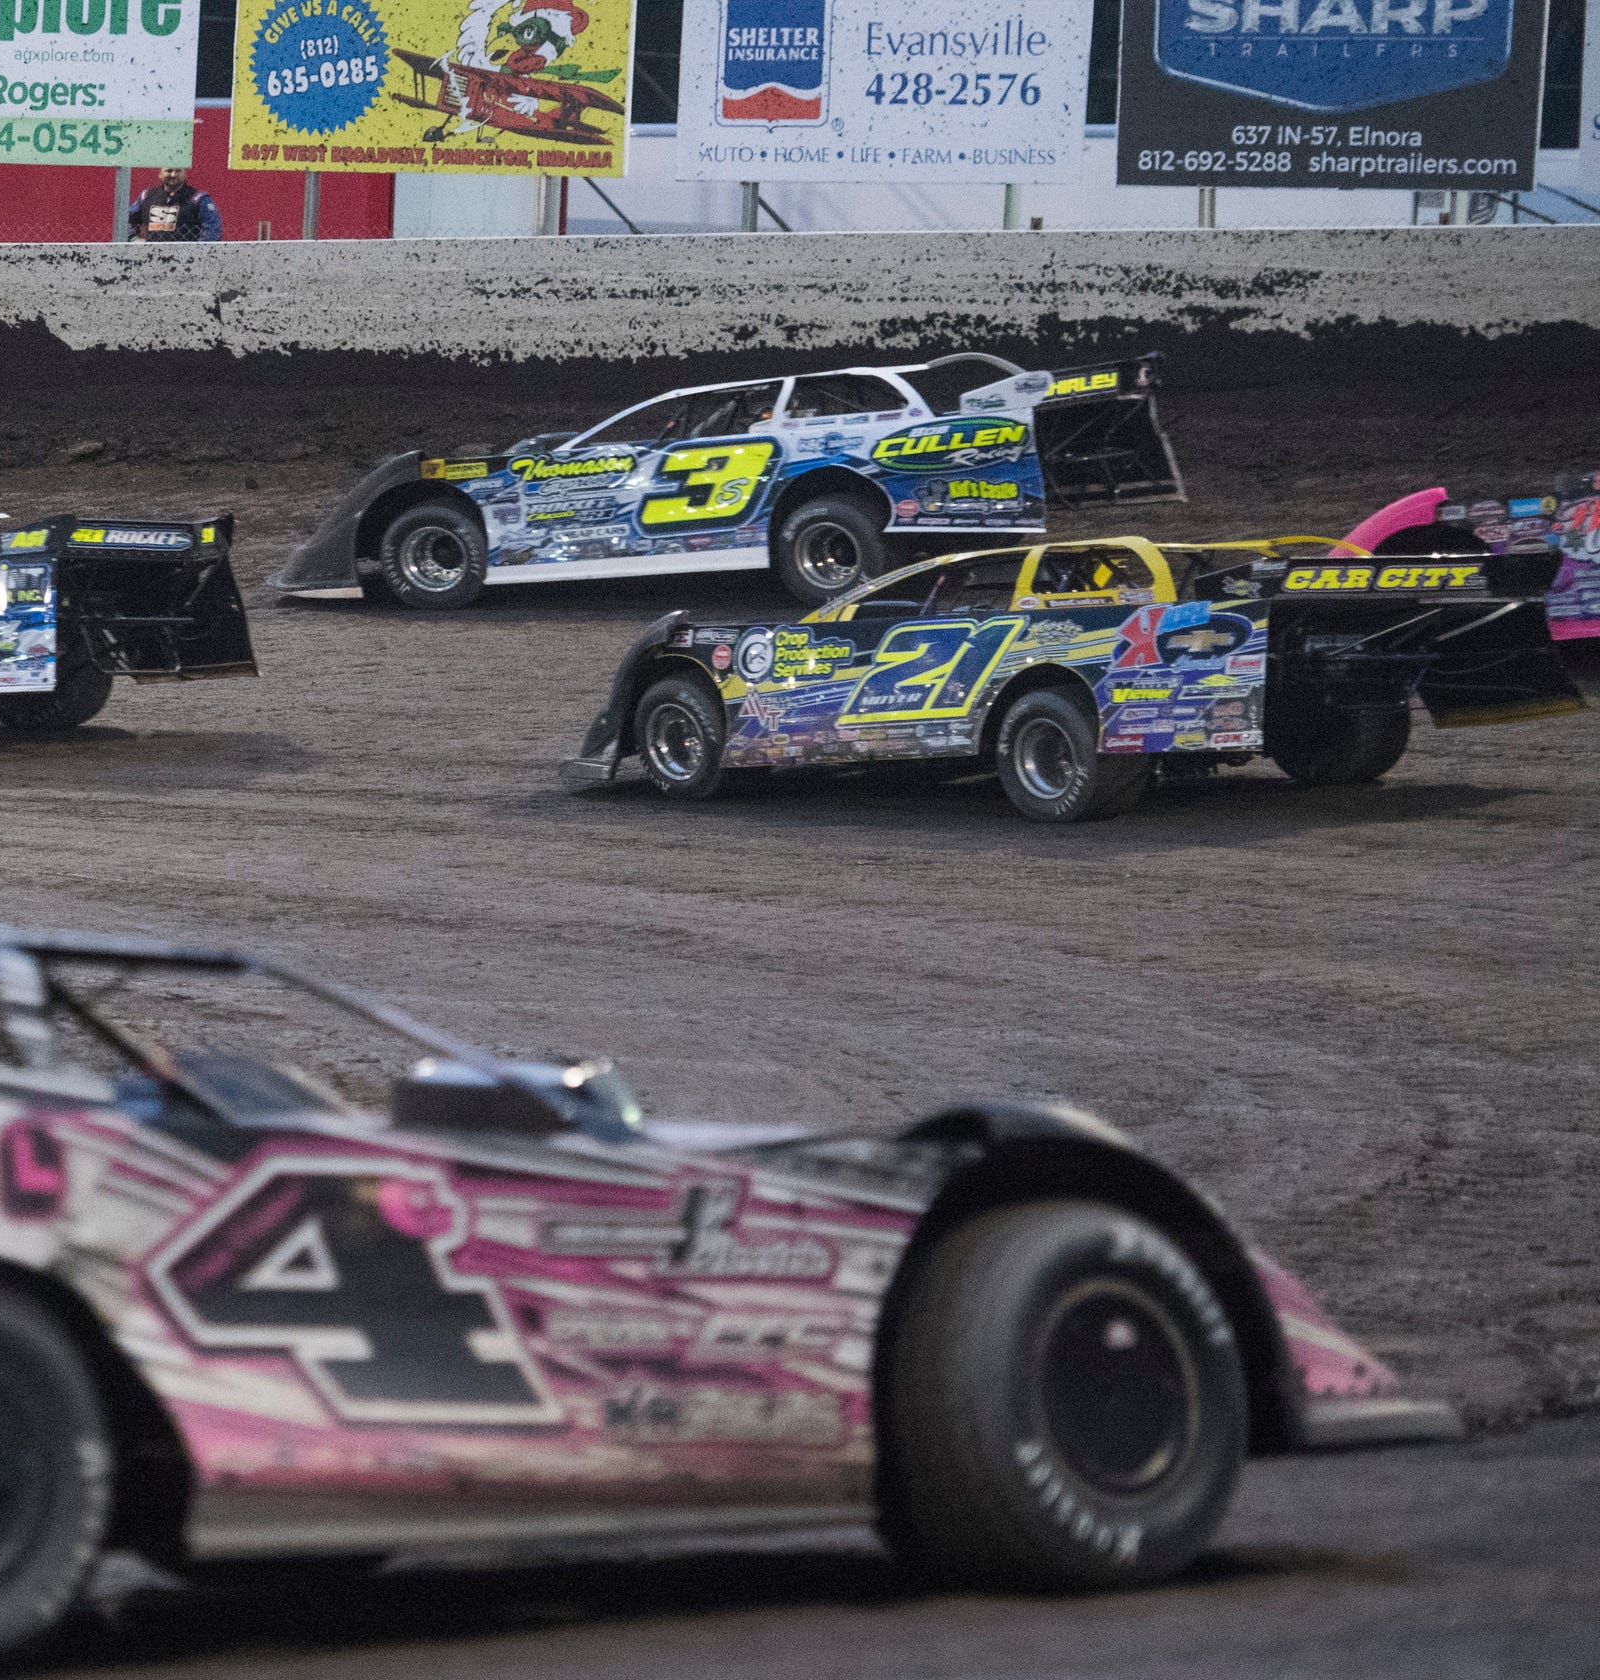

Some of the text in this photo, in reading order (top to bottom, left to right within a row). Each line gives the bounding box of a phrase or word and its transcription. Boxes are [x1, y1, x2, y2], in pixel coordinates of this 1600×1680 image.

[264, 6, 300, 44] GIVE
[300, 0, 322, 17] US
[326, 0, 337, 16] A
[300, 34, 339, 60] (812)
[727, 27, 820, 47] SHELTER
[866, 20, 1047, 58] Evansville
[14, 48, 115, 65] agxplore.com
[727, 46, 820, 62] INSURANCE
[266, 55, 379, 97] 635-0285
[865, 71, 1042, 106] 428-2576
[1231, 126, 1423, 149] 637 IN-57, Elnora
[282, 144, 328, 164] WEST
[536, 150, 613, 169] INDIANA
[701, 146, 1057, 166] AUTO HOME LIFE FARM BUSINESS
[1137, 150, 1518, 177] 812-692-5288 sharptrailers.com
[872, 424, 1026, 459] CULLEN
[511, 455, 635, 481] Thomason
[640, 441, 776, 526] 3
[1284, 566, 1480, 591] CAR CITY
[775, 630, 809, 648] Crop
[775, 643, 851, 662] Production
[837, 616, 1028, 727] 21
[145, 1148, 568, 1428] 4
